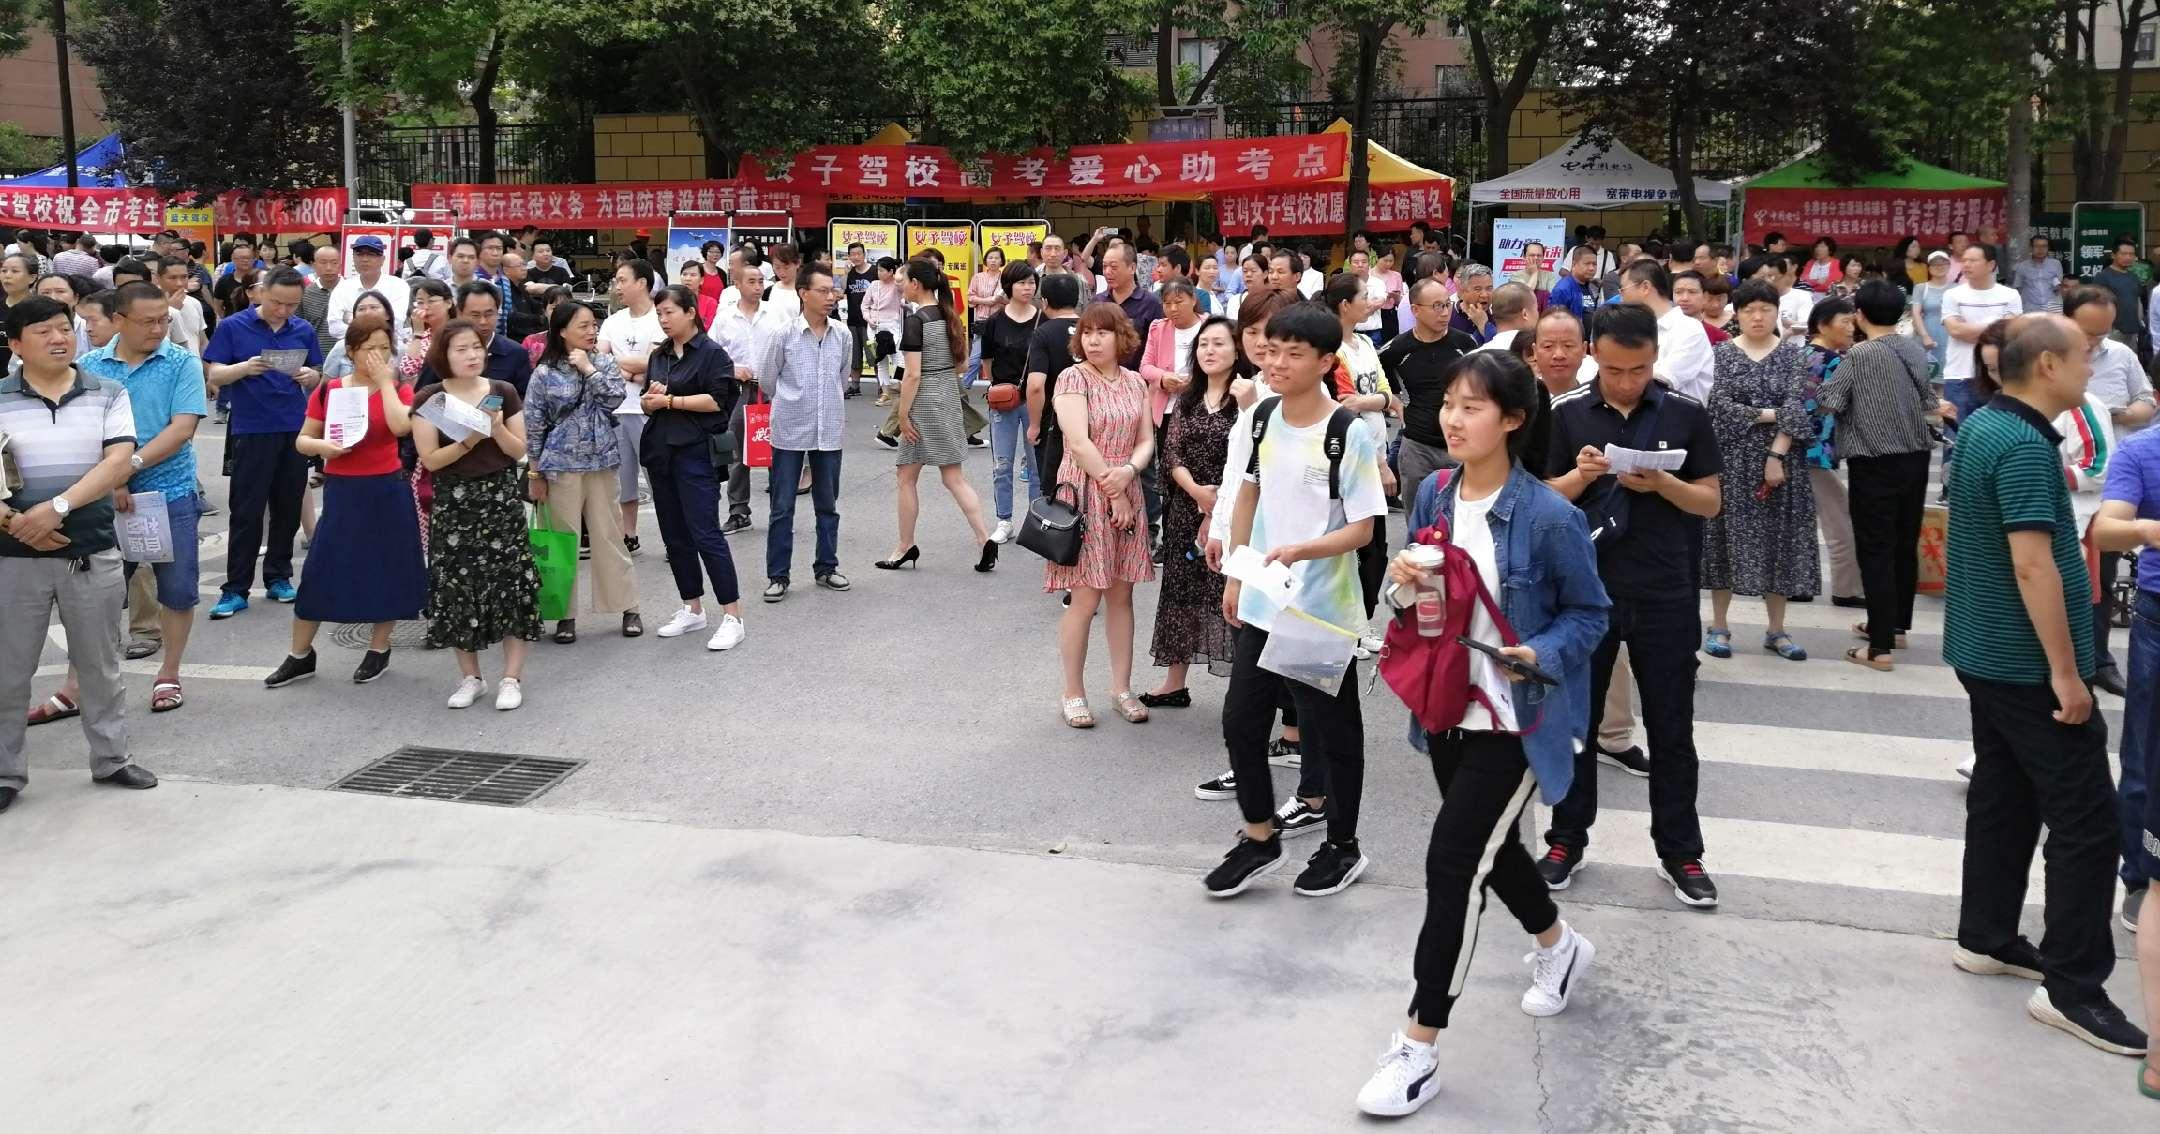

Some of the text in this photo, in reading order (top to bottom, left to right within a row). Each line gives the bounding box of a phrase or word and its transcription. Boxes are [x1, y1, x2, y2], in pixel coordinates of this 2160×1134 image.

[1499, 187, 1581, 200] 全国流量放心用
[431, 186, 759, 223] 自觉履行兵役义务 为国防建设做贡献
[842, 230, 888, 245] 女子驾校
[914, 230, 968, 246] 女子驾校
[991, 232, 1037, 246] 女子驾校
